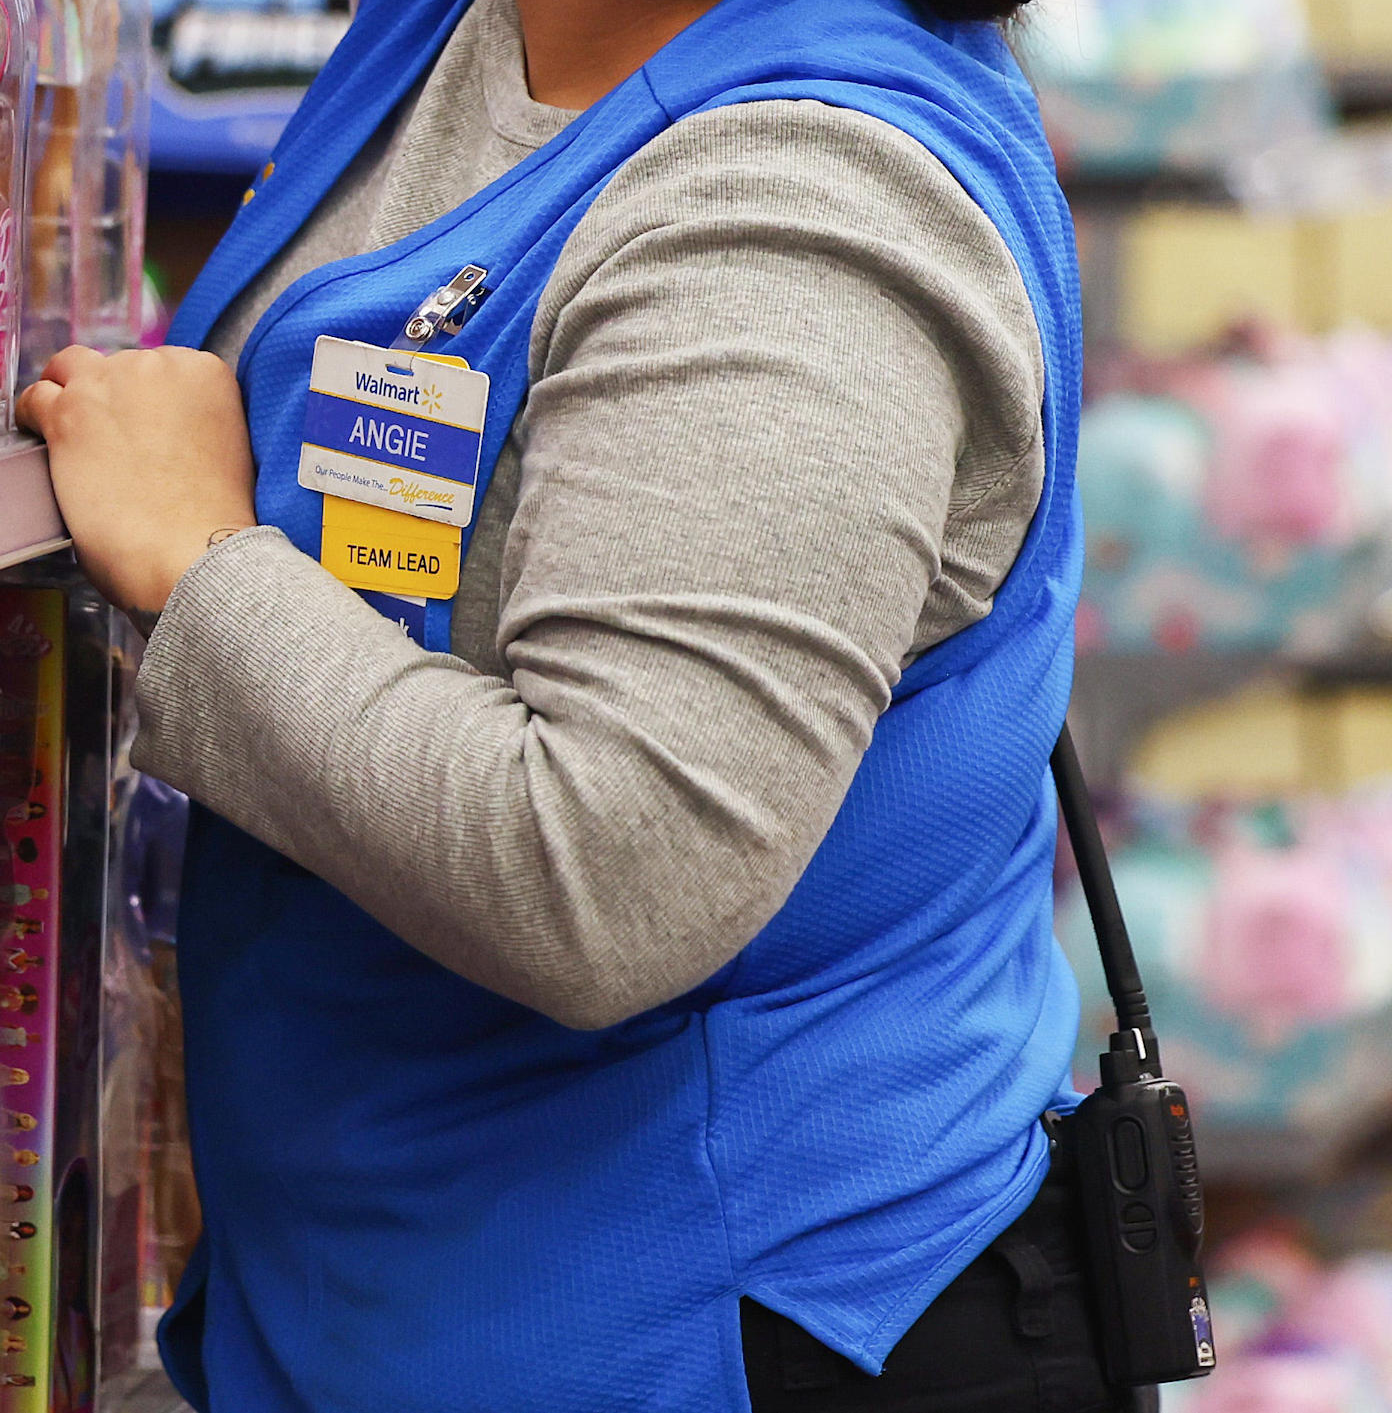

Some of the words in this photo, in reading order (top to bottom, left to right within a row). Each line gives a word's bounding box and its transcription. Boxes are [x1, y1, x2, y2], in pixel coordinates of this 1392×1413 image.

[355, 371, 420, 405] Walmart
[348, 415, 430, 462] ANGIE
[315, 464, 328, 476] Our
[328, 470, 352, 482] People
[352, 475, 371, 488] Make
[388, 477, 455, 504] Difference
[346, 544, 392, 569] TEAM
[397, 551, 441, 575] LEAD
